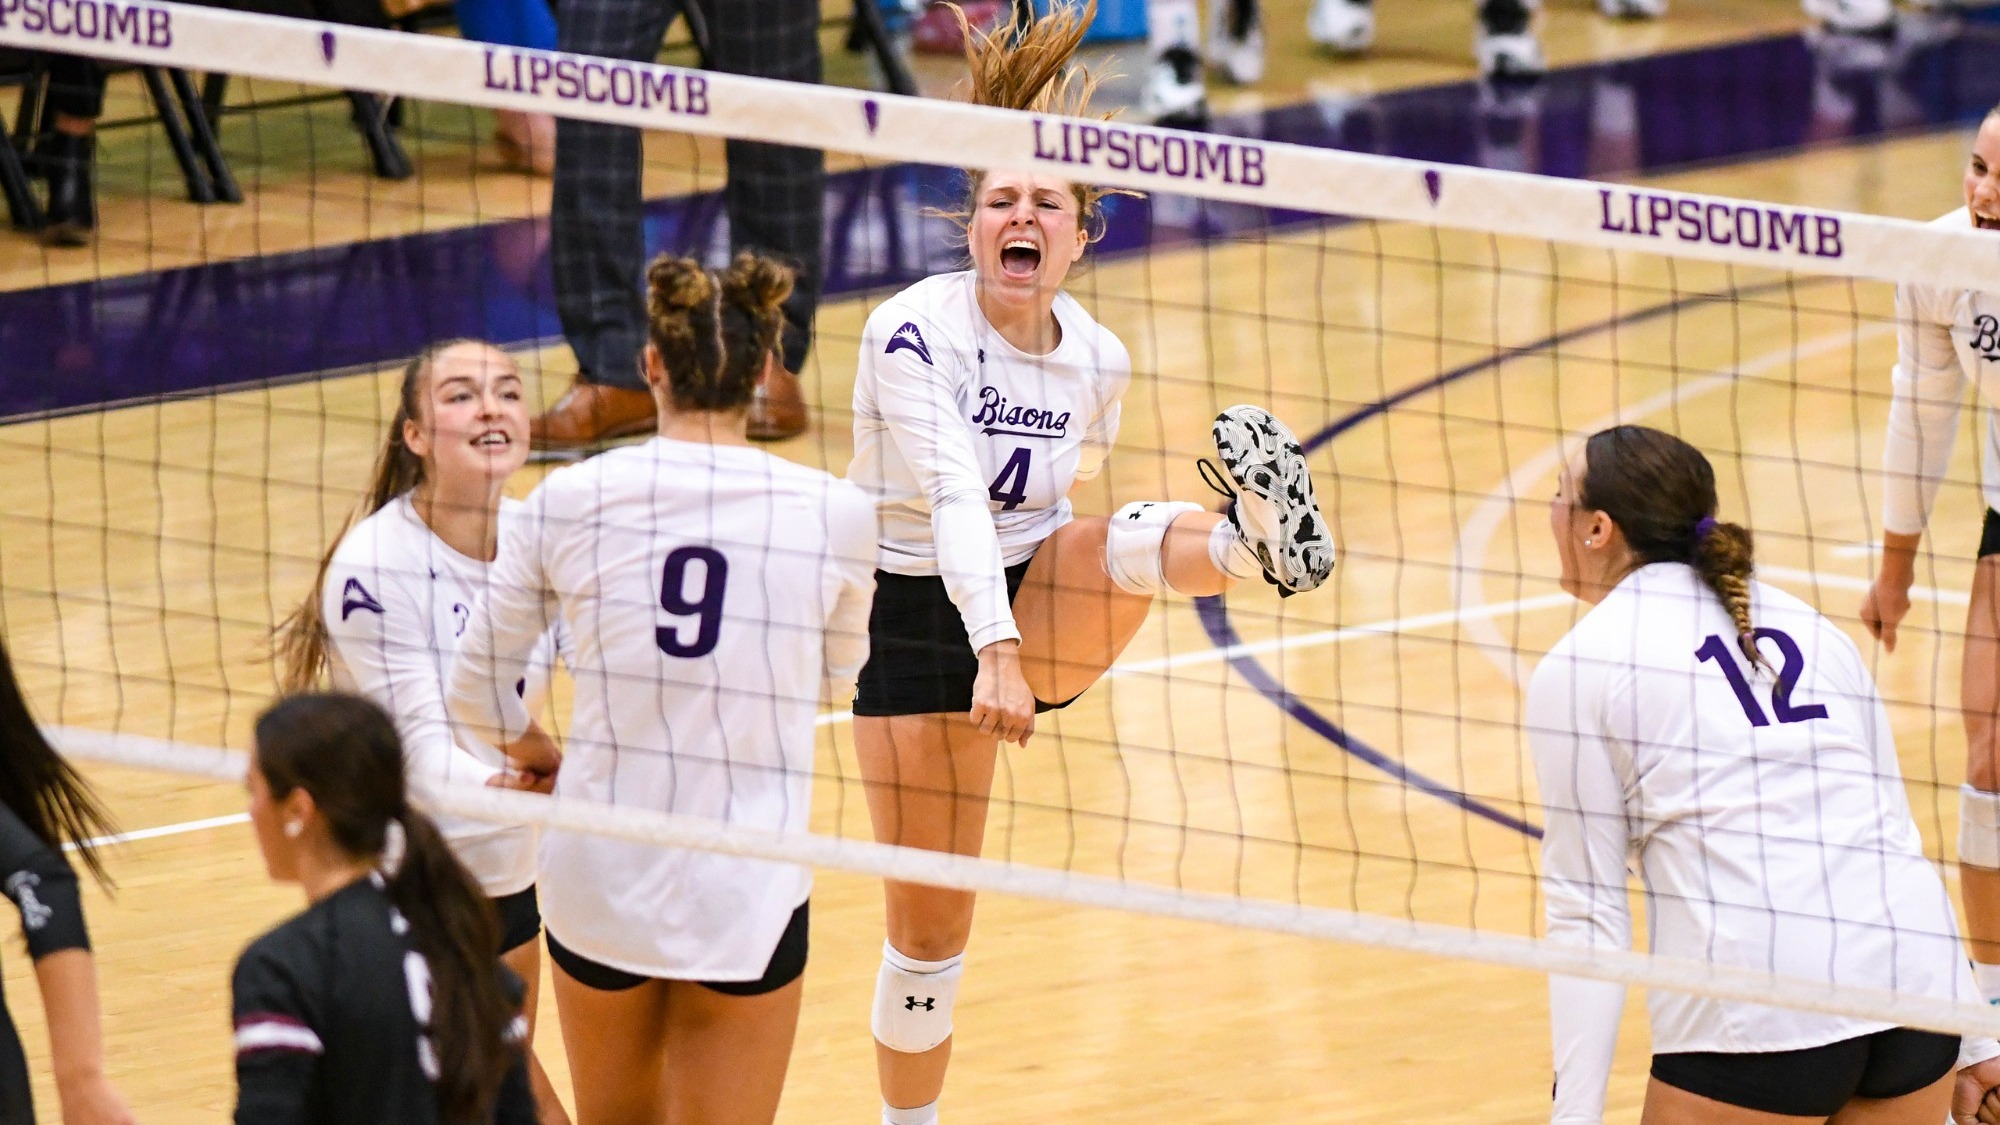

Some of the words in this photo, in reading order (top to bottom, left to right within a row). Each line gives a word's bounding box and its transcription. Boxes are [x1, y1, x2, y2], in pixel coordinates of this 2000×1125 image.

[484, 50, 709, 115] LIPSCOMB
[1033, 119, 1266, 187] LIPSCOMB
[1599, 189, 1843, 258] LIPSCOMB
[972, 385, 1071, 431] Bisons
[989, 447, 1031, 510] 4
[655, 546, 729, 658] 9
[1694, 627, 1829, 727] 12
